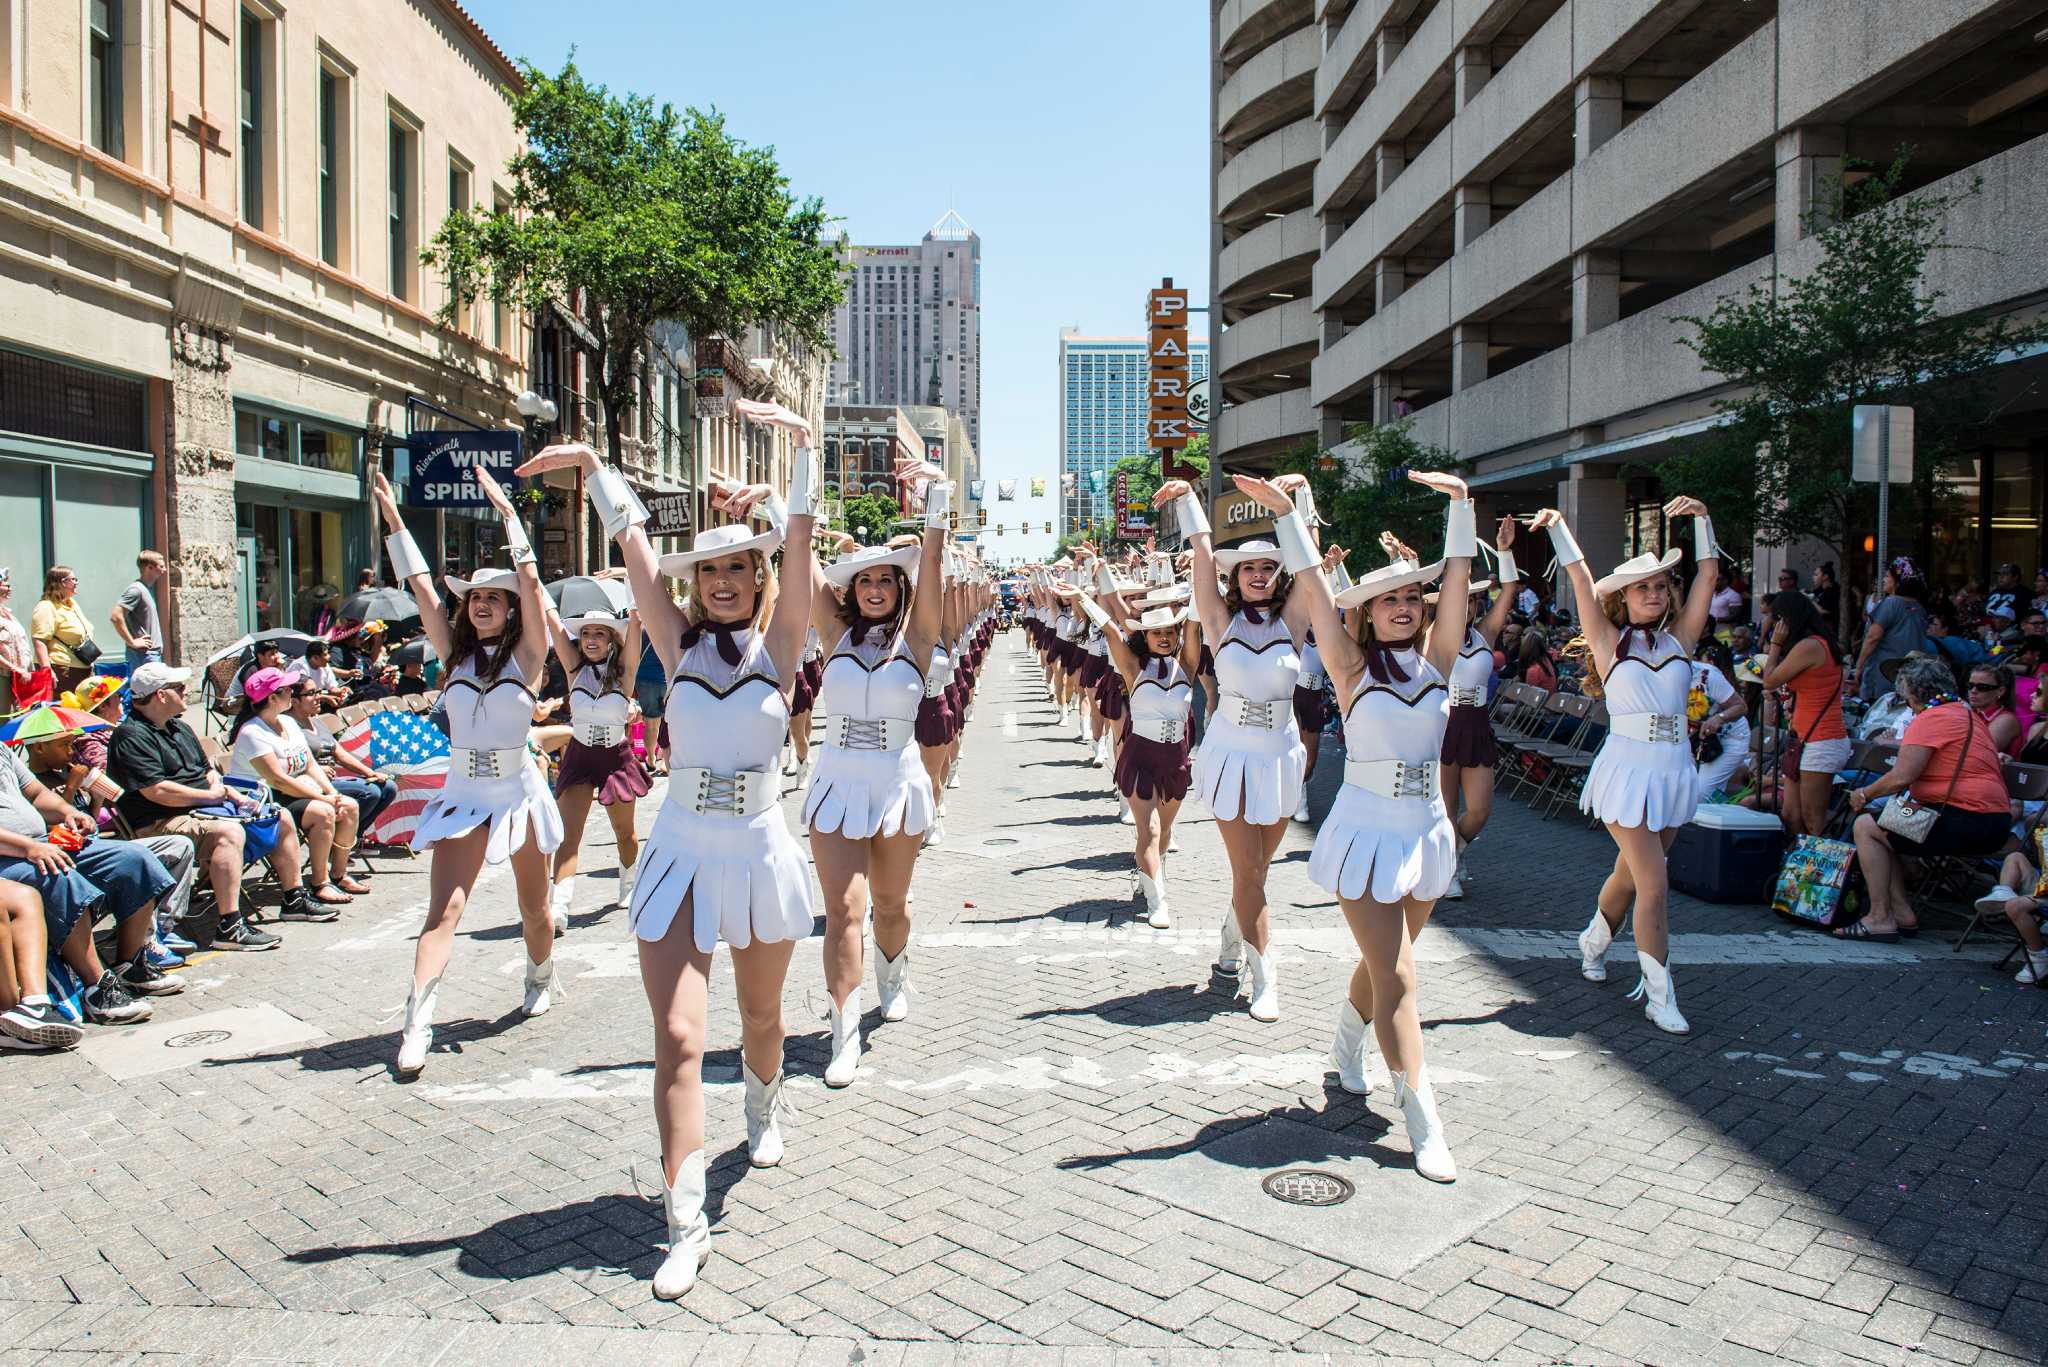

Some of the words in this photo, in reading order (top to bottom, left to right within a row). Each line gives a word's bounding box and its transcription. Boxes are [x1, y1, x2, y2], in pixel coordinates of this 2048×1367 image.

[1153, 296, 1187, 438] PARK
[416, 438, 460, 476] Riverwalk
[449, 450, 513, 468] WINE
[462, 469, 475, 481] &
[424, 482, 513, 500] SPIRIS
[647, 494, 689, 511] COYOTE
